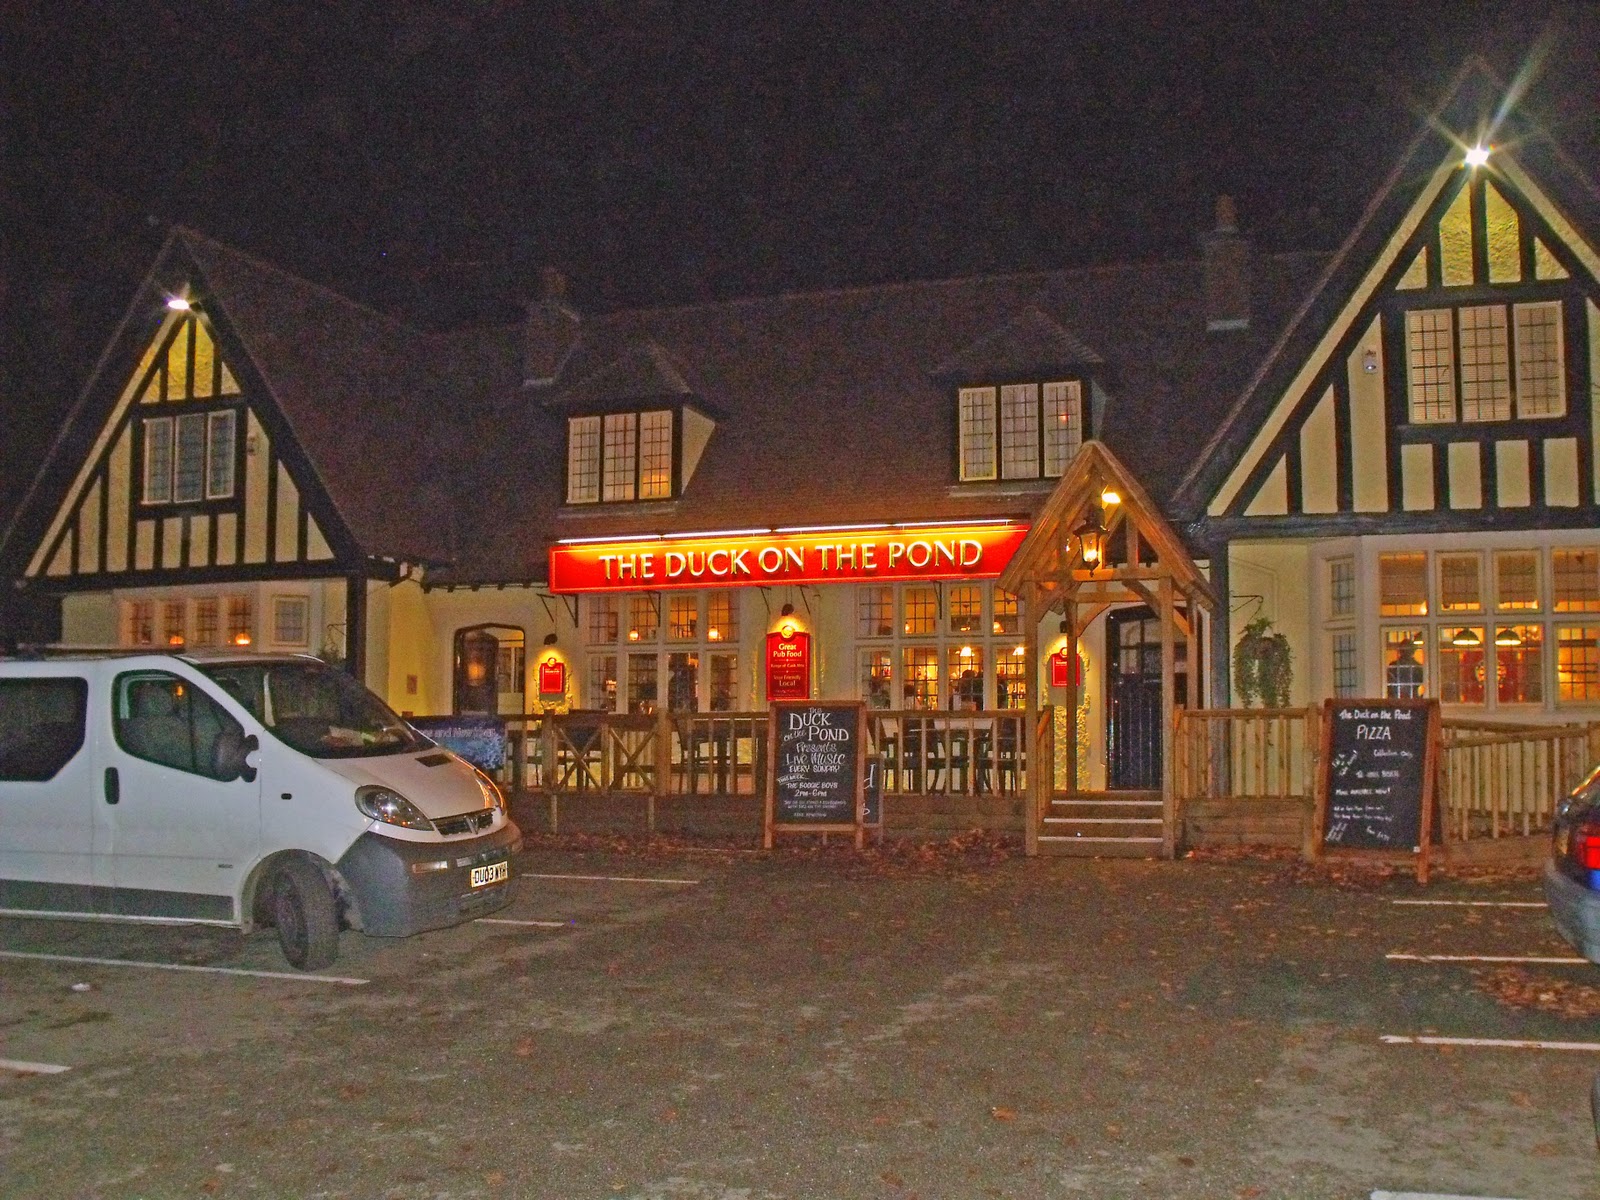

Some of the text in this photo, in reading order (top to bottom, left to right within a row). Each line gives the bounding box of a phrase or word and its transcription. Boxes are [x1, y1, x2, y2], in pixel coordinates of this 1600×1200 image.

[598, 539, 983, 580] THE DUCK ON THE POND
[789, 712, 832, 730] DUCK
[1339, 709, 1352, 720] The
[1354, 709, 1370, 720] Duck
[1394, 708, 1412, 720] Pond
[808, 725, 850, 741] POND
[1356, 724, 1392, 740] PIZZA
[789, 765, 841, 773] EVERY SUNDAY
